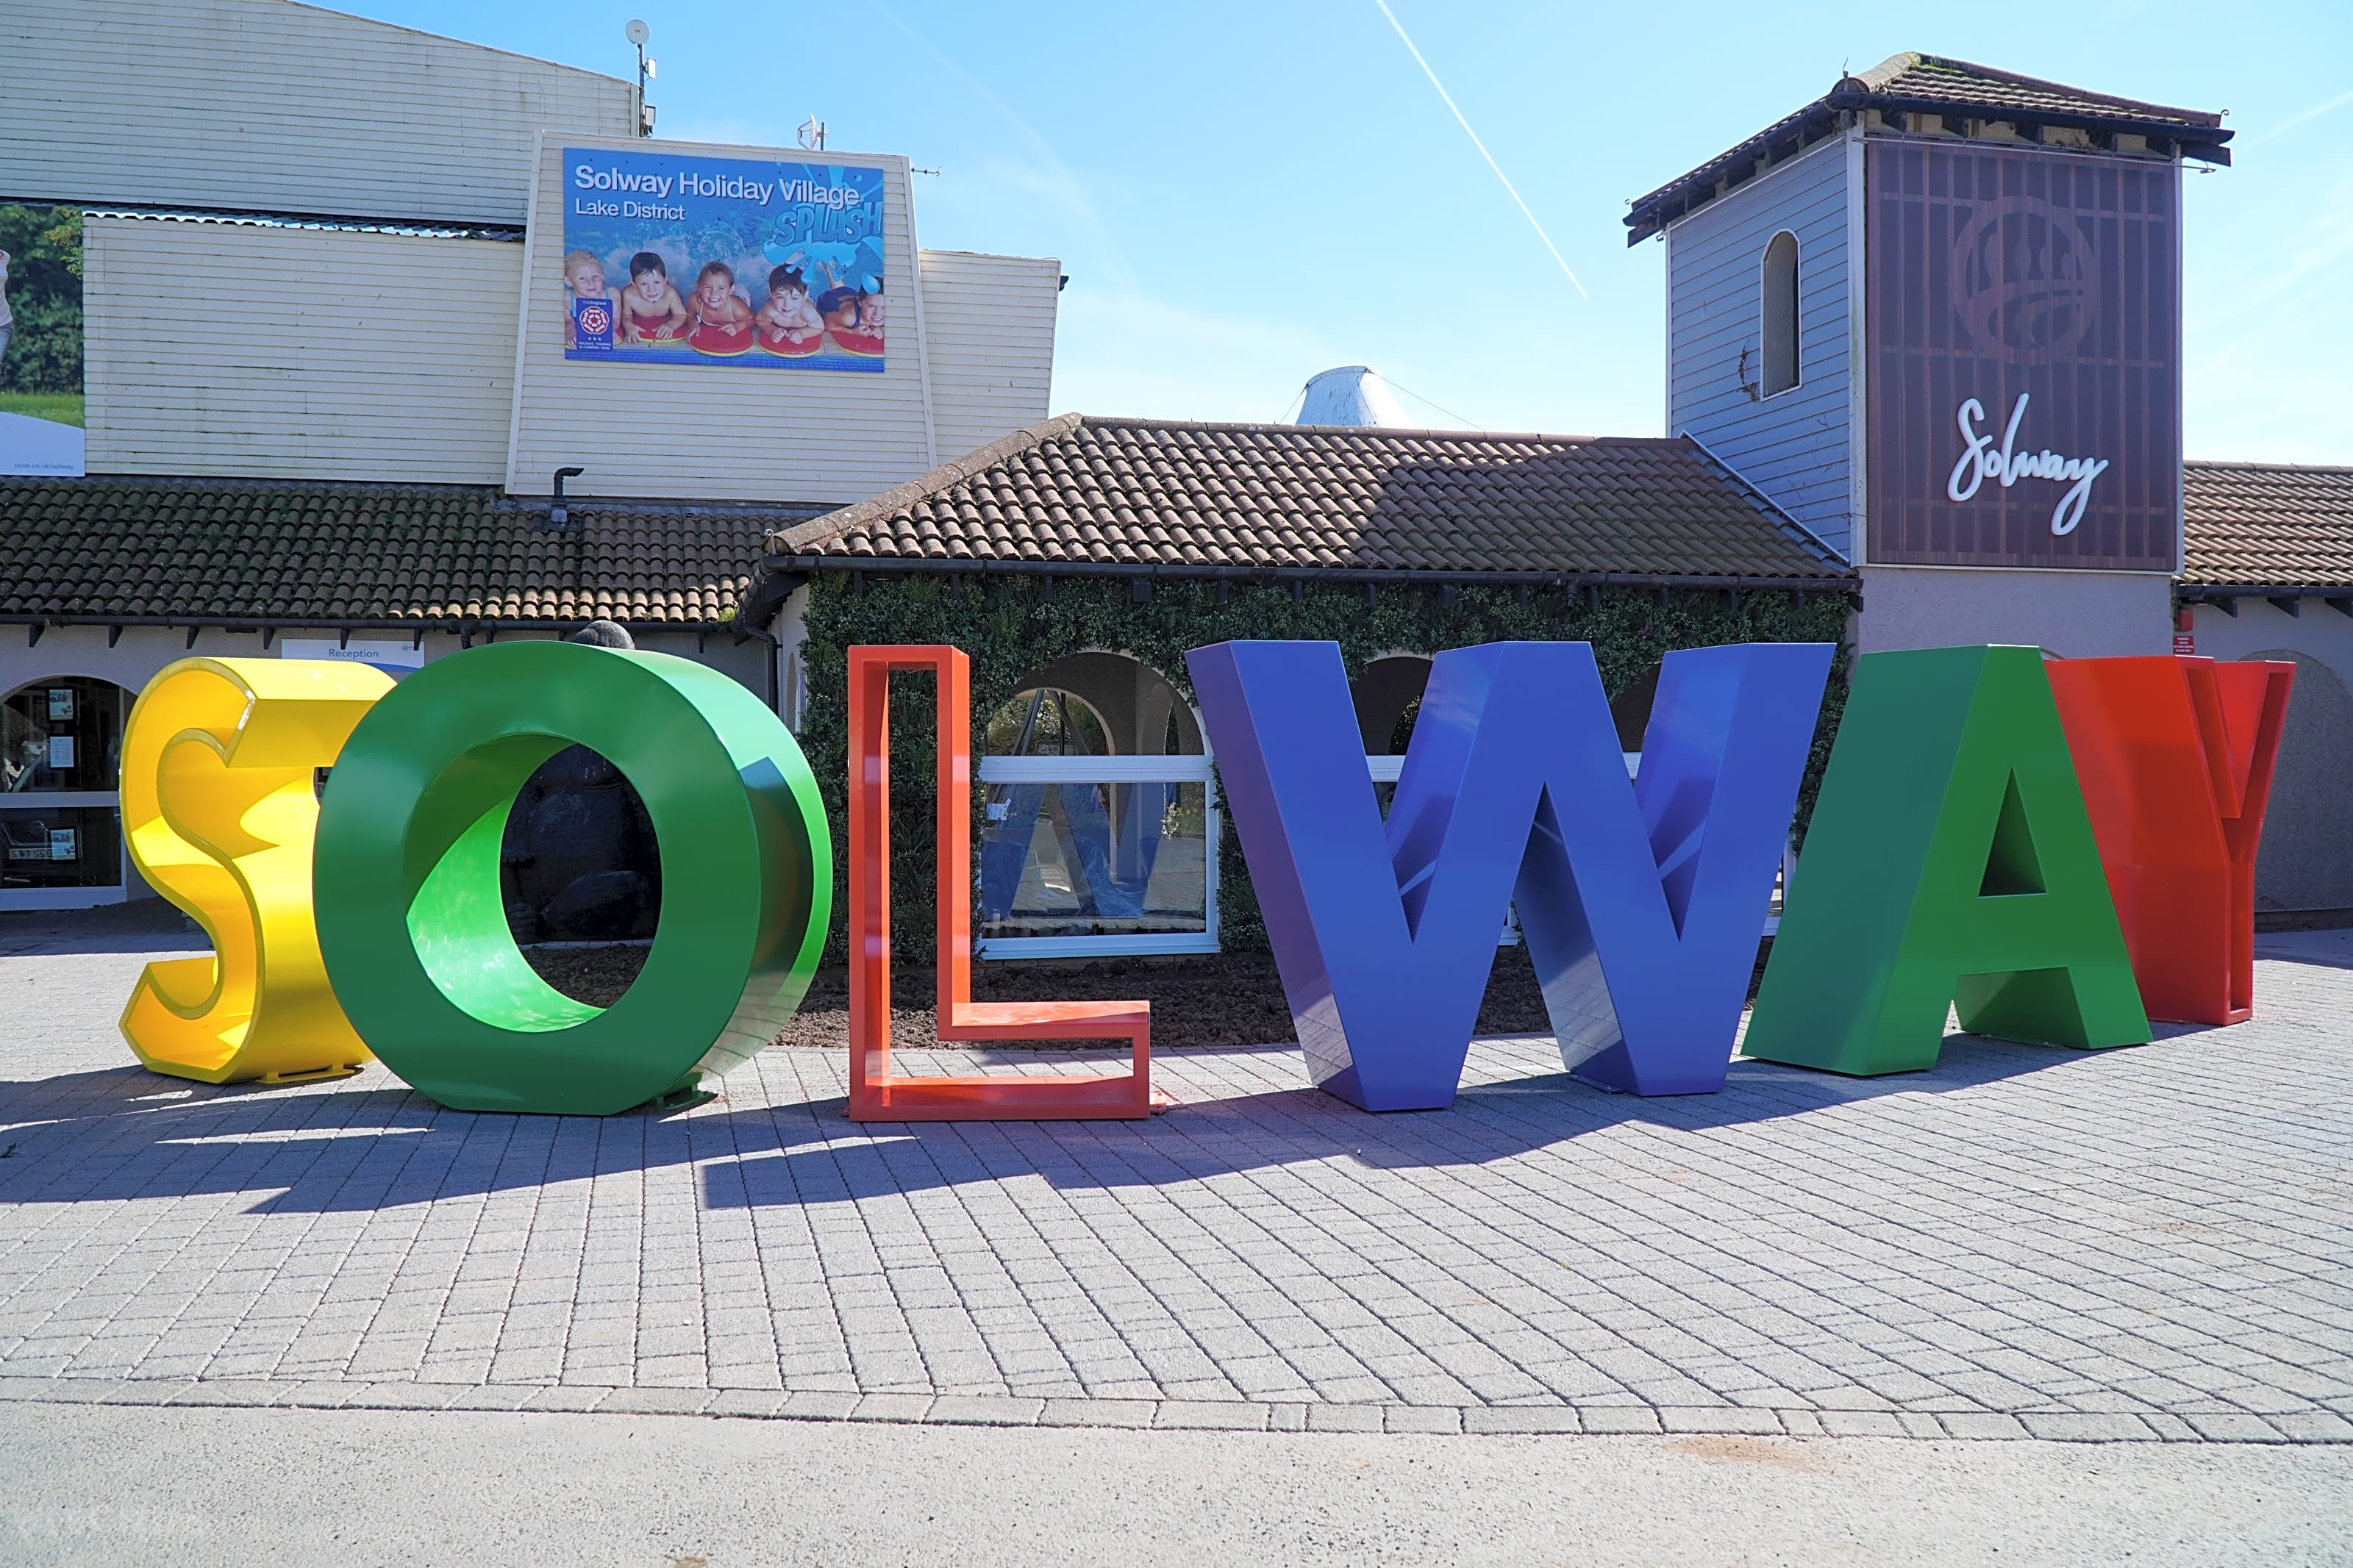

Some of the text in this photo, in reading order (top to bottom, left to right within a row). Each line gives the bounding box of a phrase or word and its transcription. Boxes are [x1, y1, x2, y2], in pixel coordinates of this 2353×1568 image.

[575, 165, 860, 210] Solway Holiday Village
[576, 198, 686, 221] Lake District
[774, 201, 883, 247] SPLASH
[14, 462, 74, 471] cove.co.uk/solway
[1948, 393, 2109, 536] Solway
[329, 648, 379, 659] Reception
[118, 639, 2296, 1122] SOLWAY
